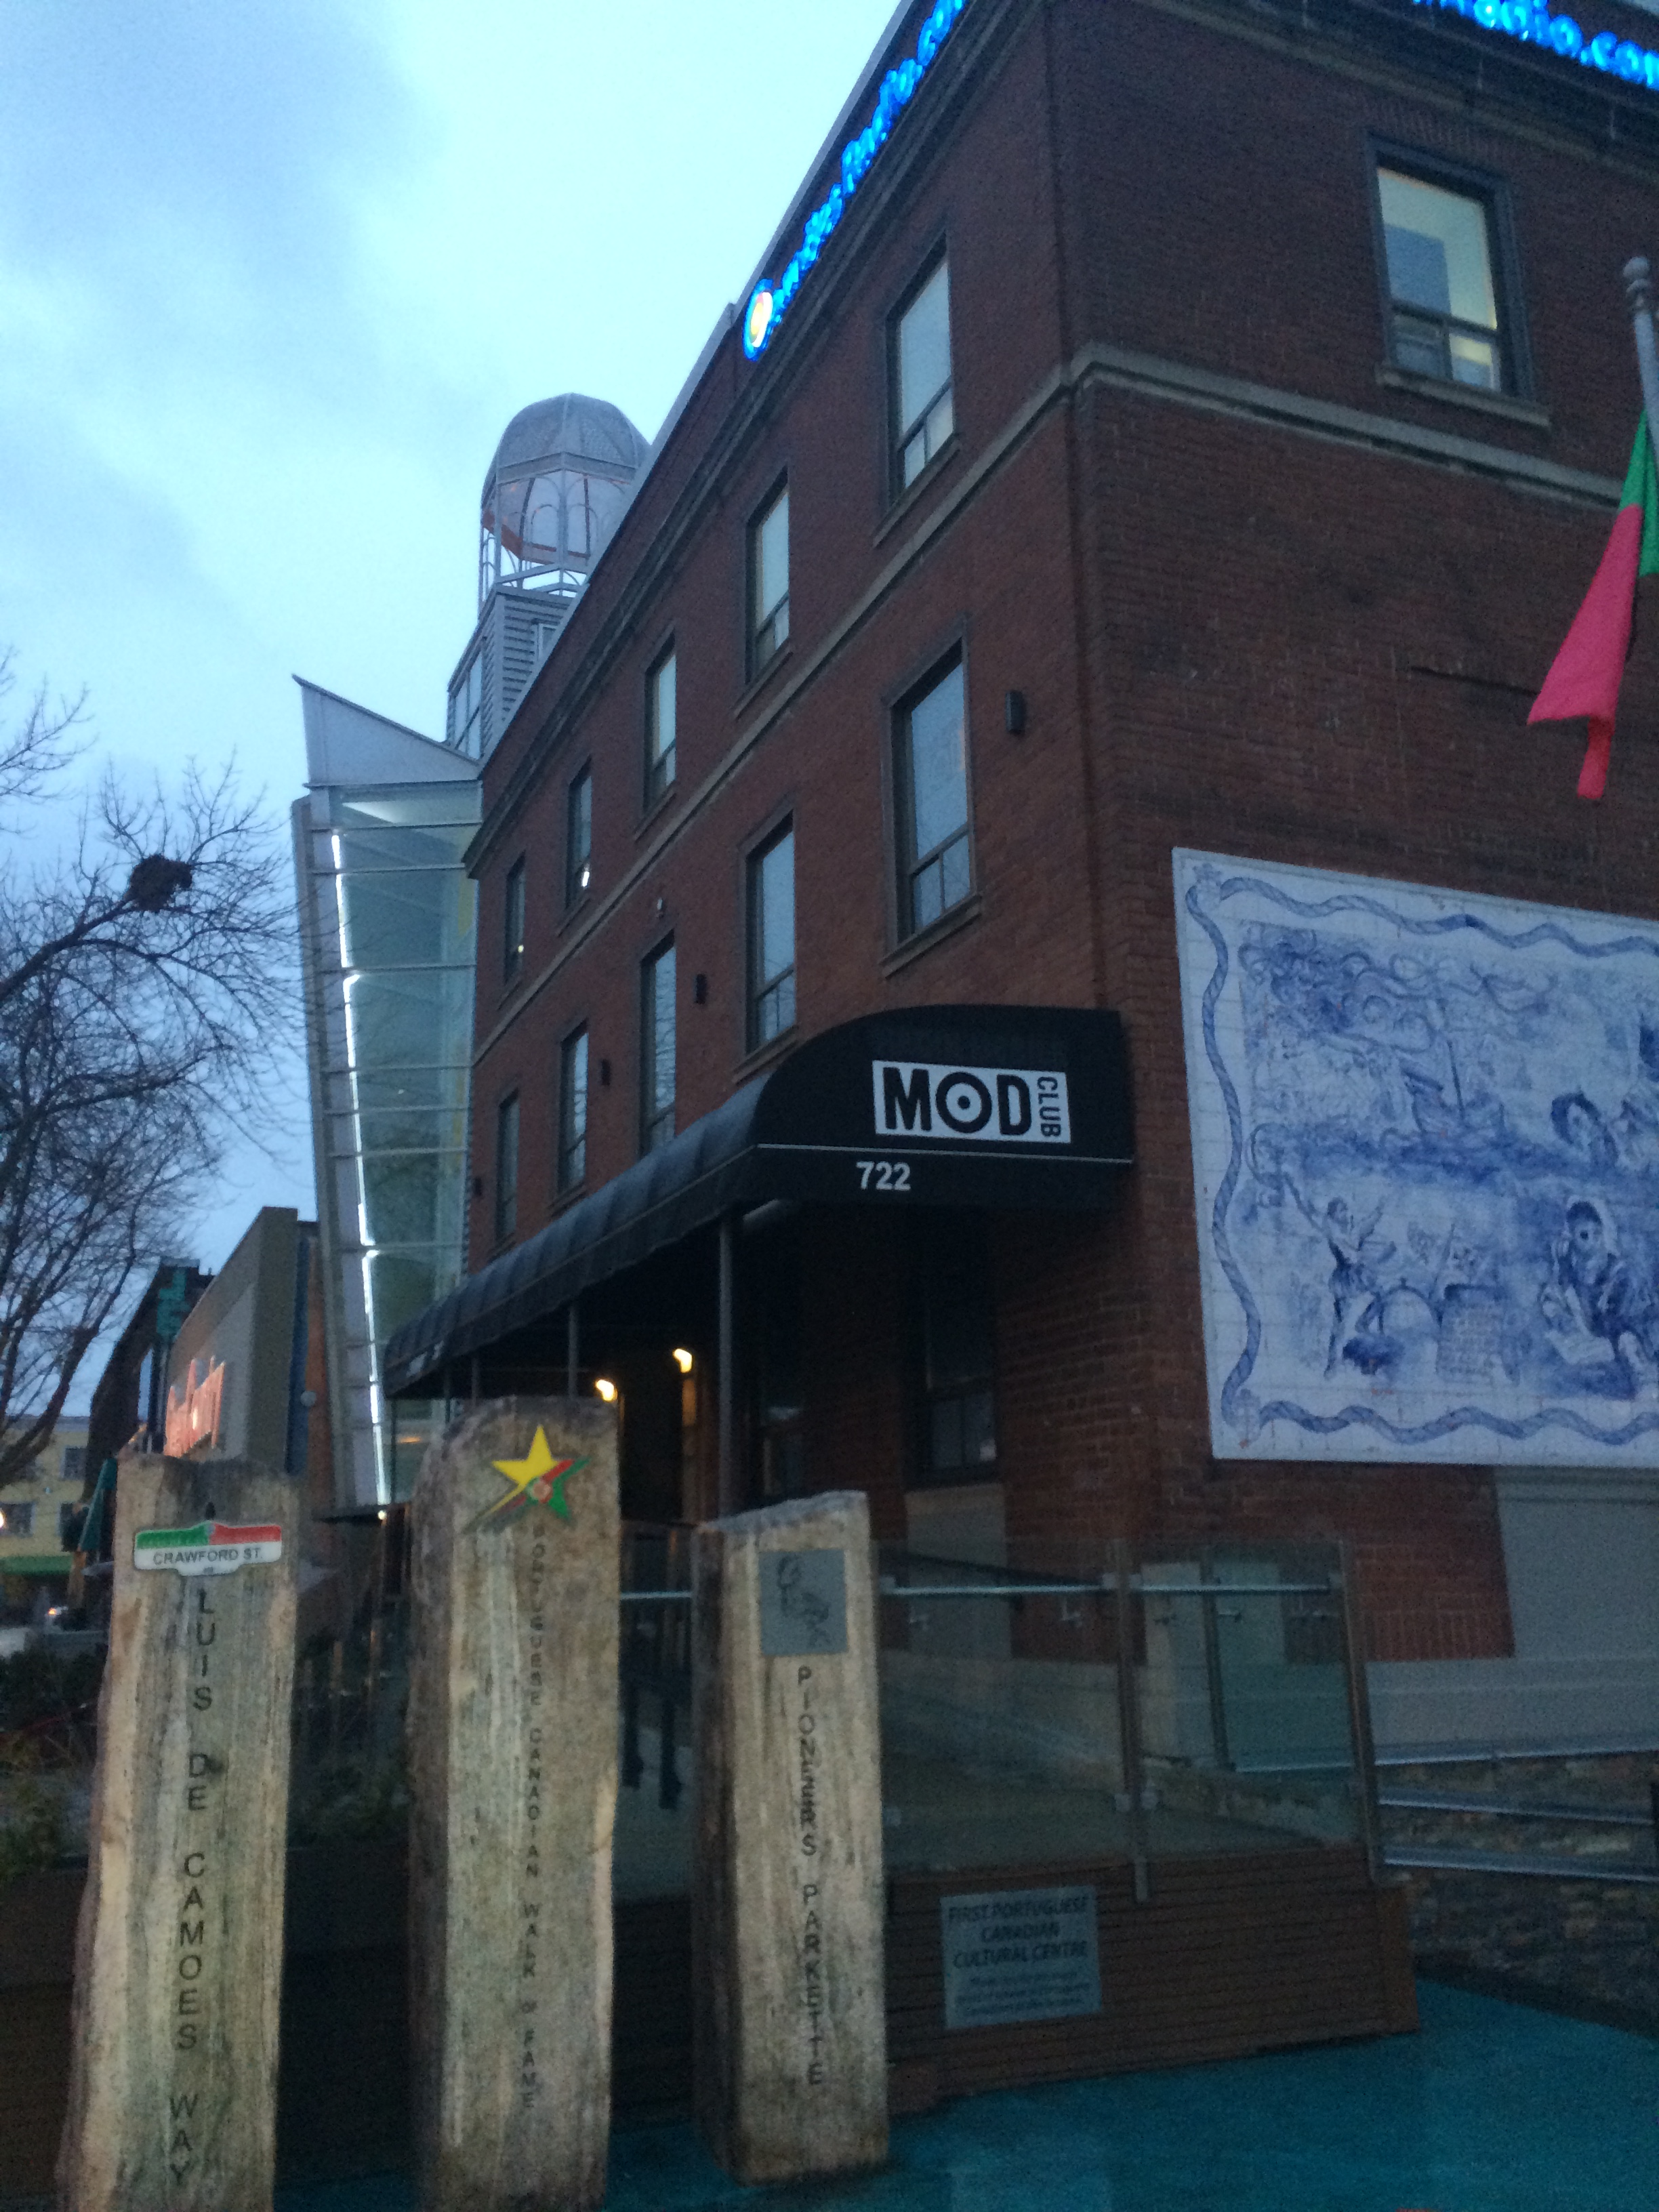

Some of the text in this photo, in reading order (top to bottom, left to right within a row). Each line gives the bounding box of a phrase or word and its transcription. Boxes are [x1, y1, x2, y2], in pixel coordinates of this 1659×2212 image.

[882, 1066, 1062, 1139] MOD CLUB
[856, 1161, 912, 1191] 722
[153, 1549, 239, 1565] CRAWFORD
[192, 1587, 216, 1711] LUIS
[187, 1752, 210, 1811] DE
[527, 1727, 543, 1878] CANADIAN
[798, 1665, 823, 2085] PIONEERS PARKETTE
[175, 1853, 205, 2051] CAMOES
[523, 1903, 540, 1978] WALK
[953, 1940, 1089, 1969] CULTURAL CENTRE
[981, 1921, 1061, 1943] CANADIAN
[522, 2028, 537, 2108] FAME
[169, 2093, 199, 2186] WAY
